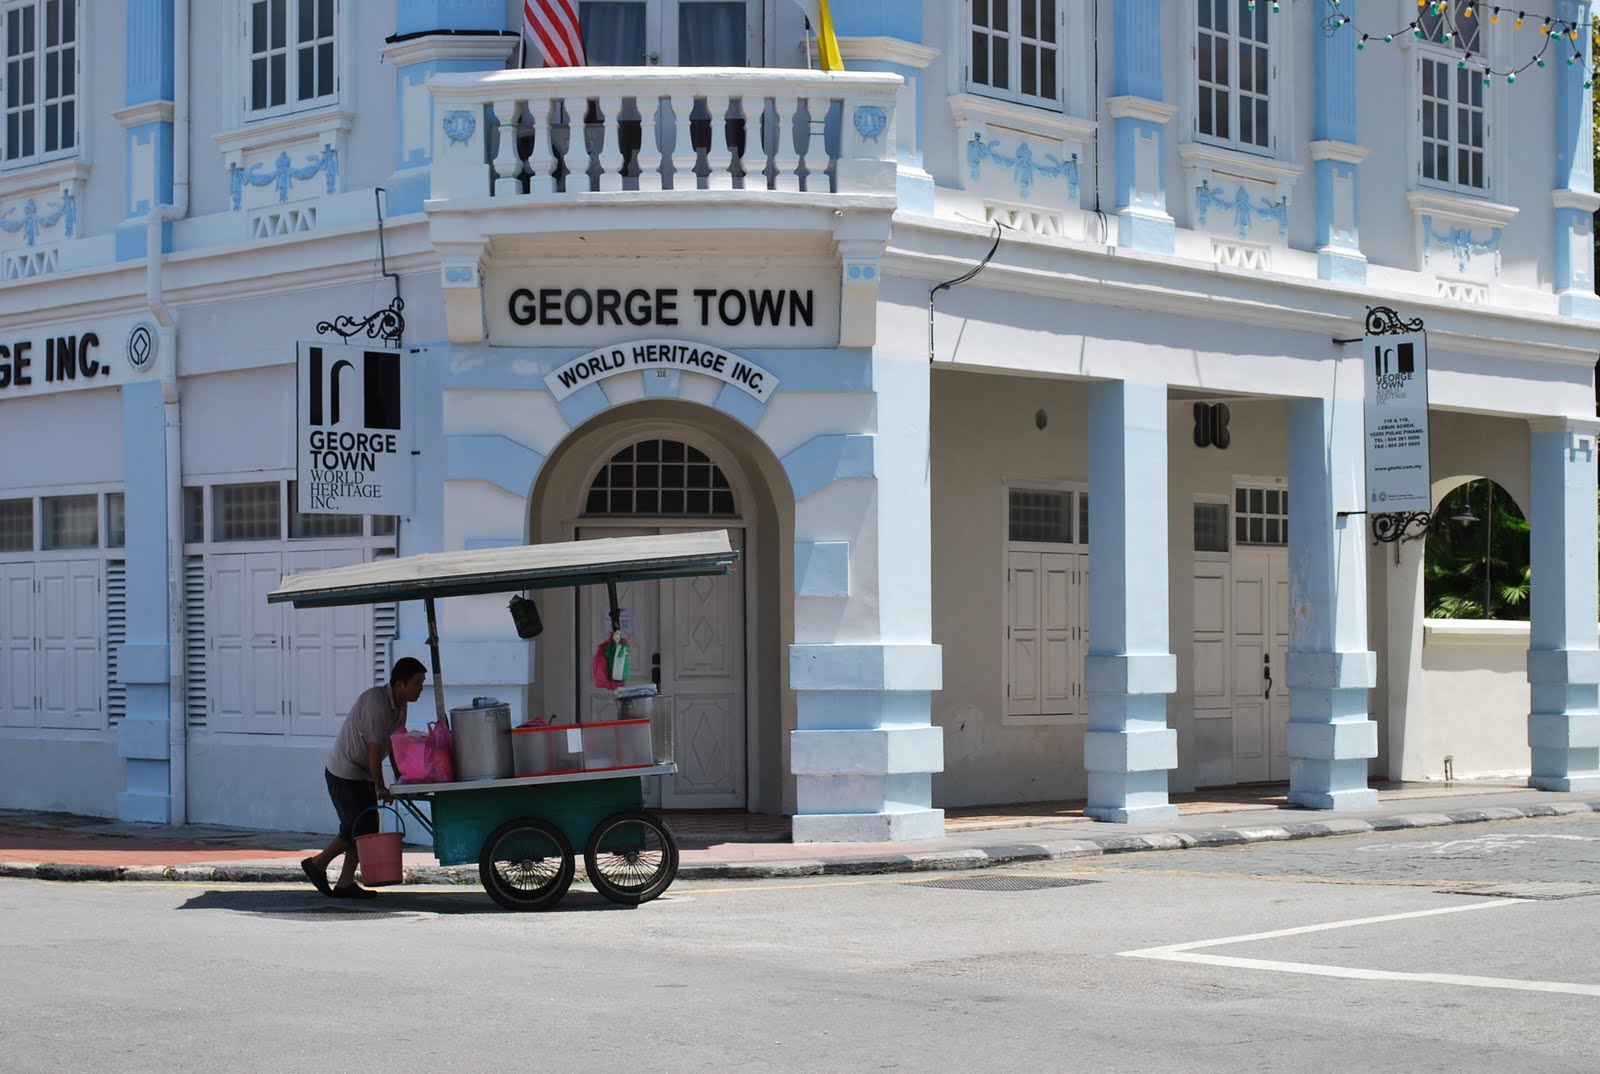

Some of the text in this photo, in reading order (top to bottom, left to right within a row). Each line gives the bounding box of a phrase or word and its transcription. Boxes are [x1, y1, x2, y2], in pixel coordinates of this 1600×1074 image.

[508, 288, 814, 327] GEORGE TOWN
[45, 332, 110, 382] INC.
[557, 344, 764, 394] WORLD HERITAGE INC.
[1376, 373, 1413, 382] GEORGE
[1376, 381, 1404, 390] TOWN
[309, 430, 397, 454] GEORGE
[309, 450, 376, 472] TOWN
[310, 469, 365, 485] WORLD
[310, 482, 382, 499] HERITAGE
[310, 495, 339, 510] INC.
